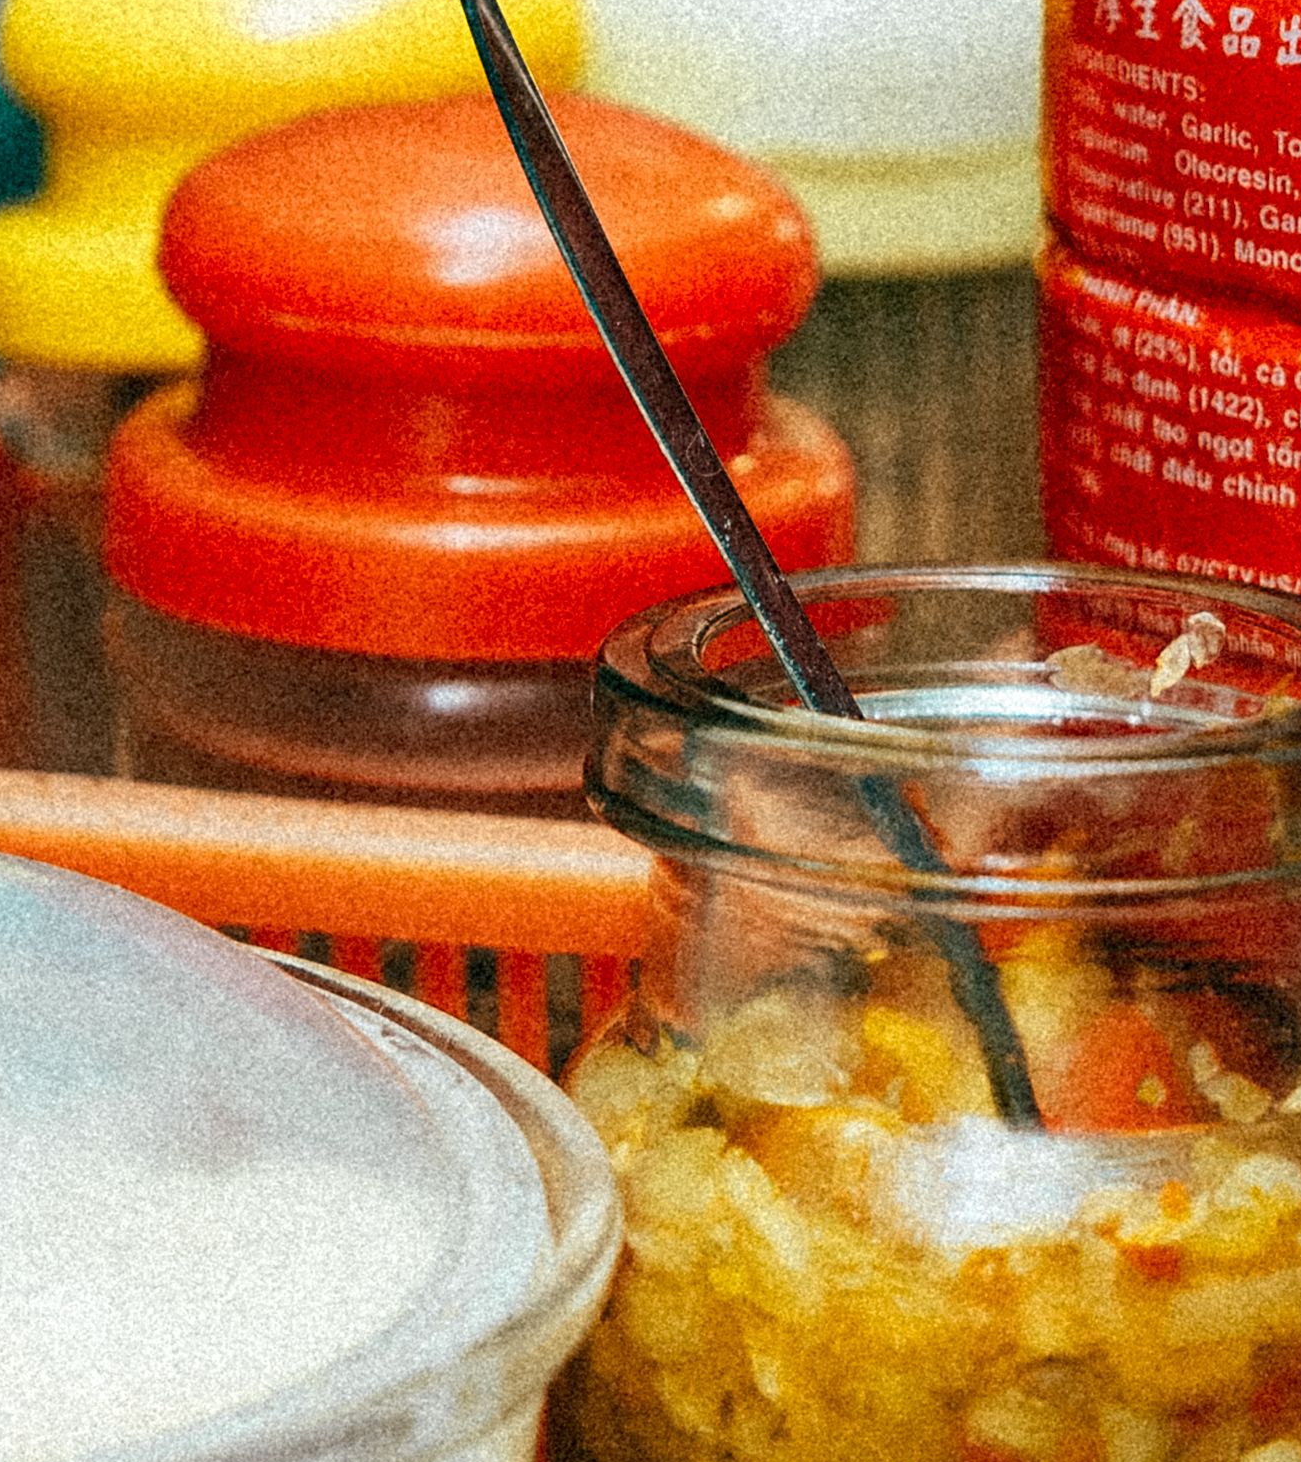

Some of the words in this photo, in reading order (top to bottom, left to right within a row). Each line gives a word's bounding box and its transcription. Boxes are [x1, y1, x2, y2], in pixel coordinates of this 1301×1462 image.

[1181, 113, 1258, 157] Garlic,
[1175, 149, 1301, 200] Oleoresin,
[1183, 189, 1249, 229] (211),
[1188, 384, 1272, 429] (1422),
